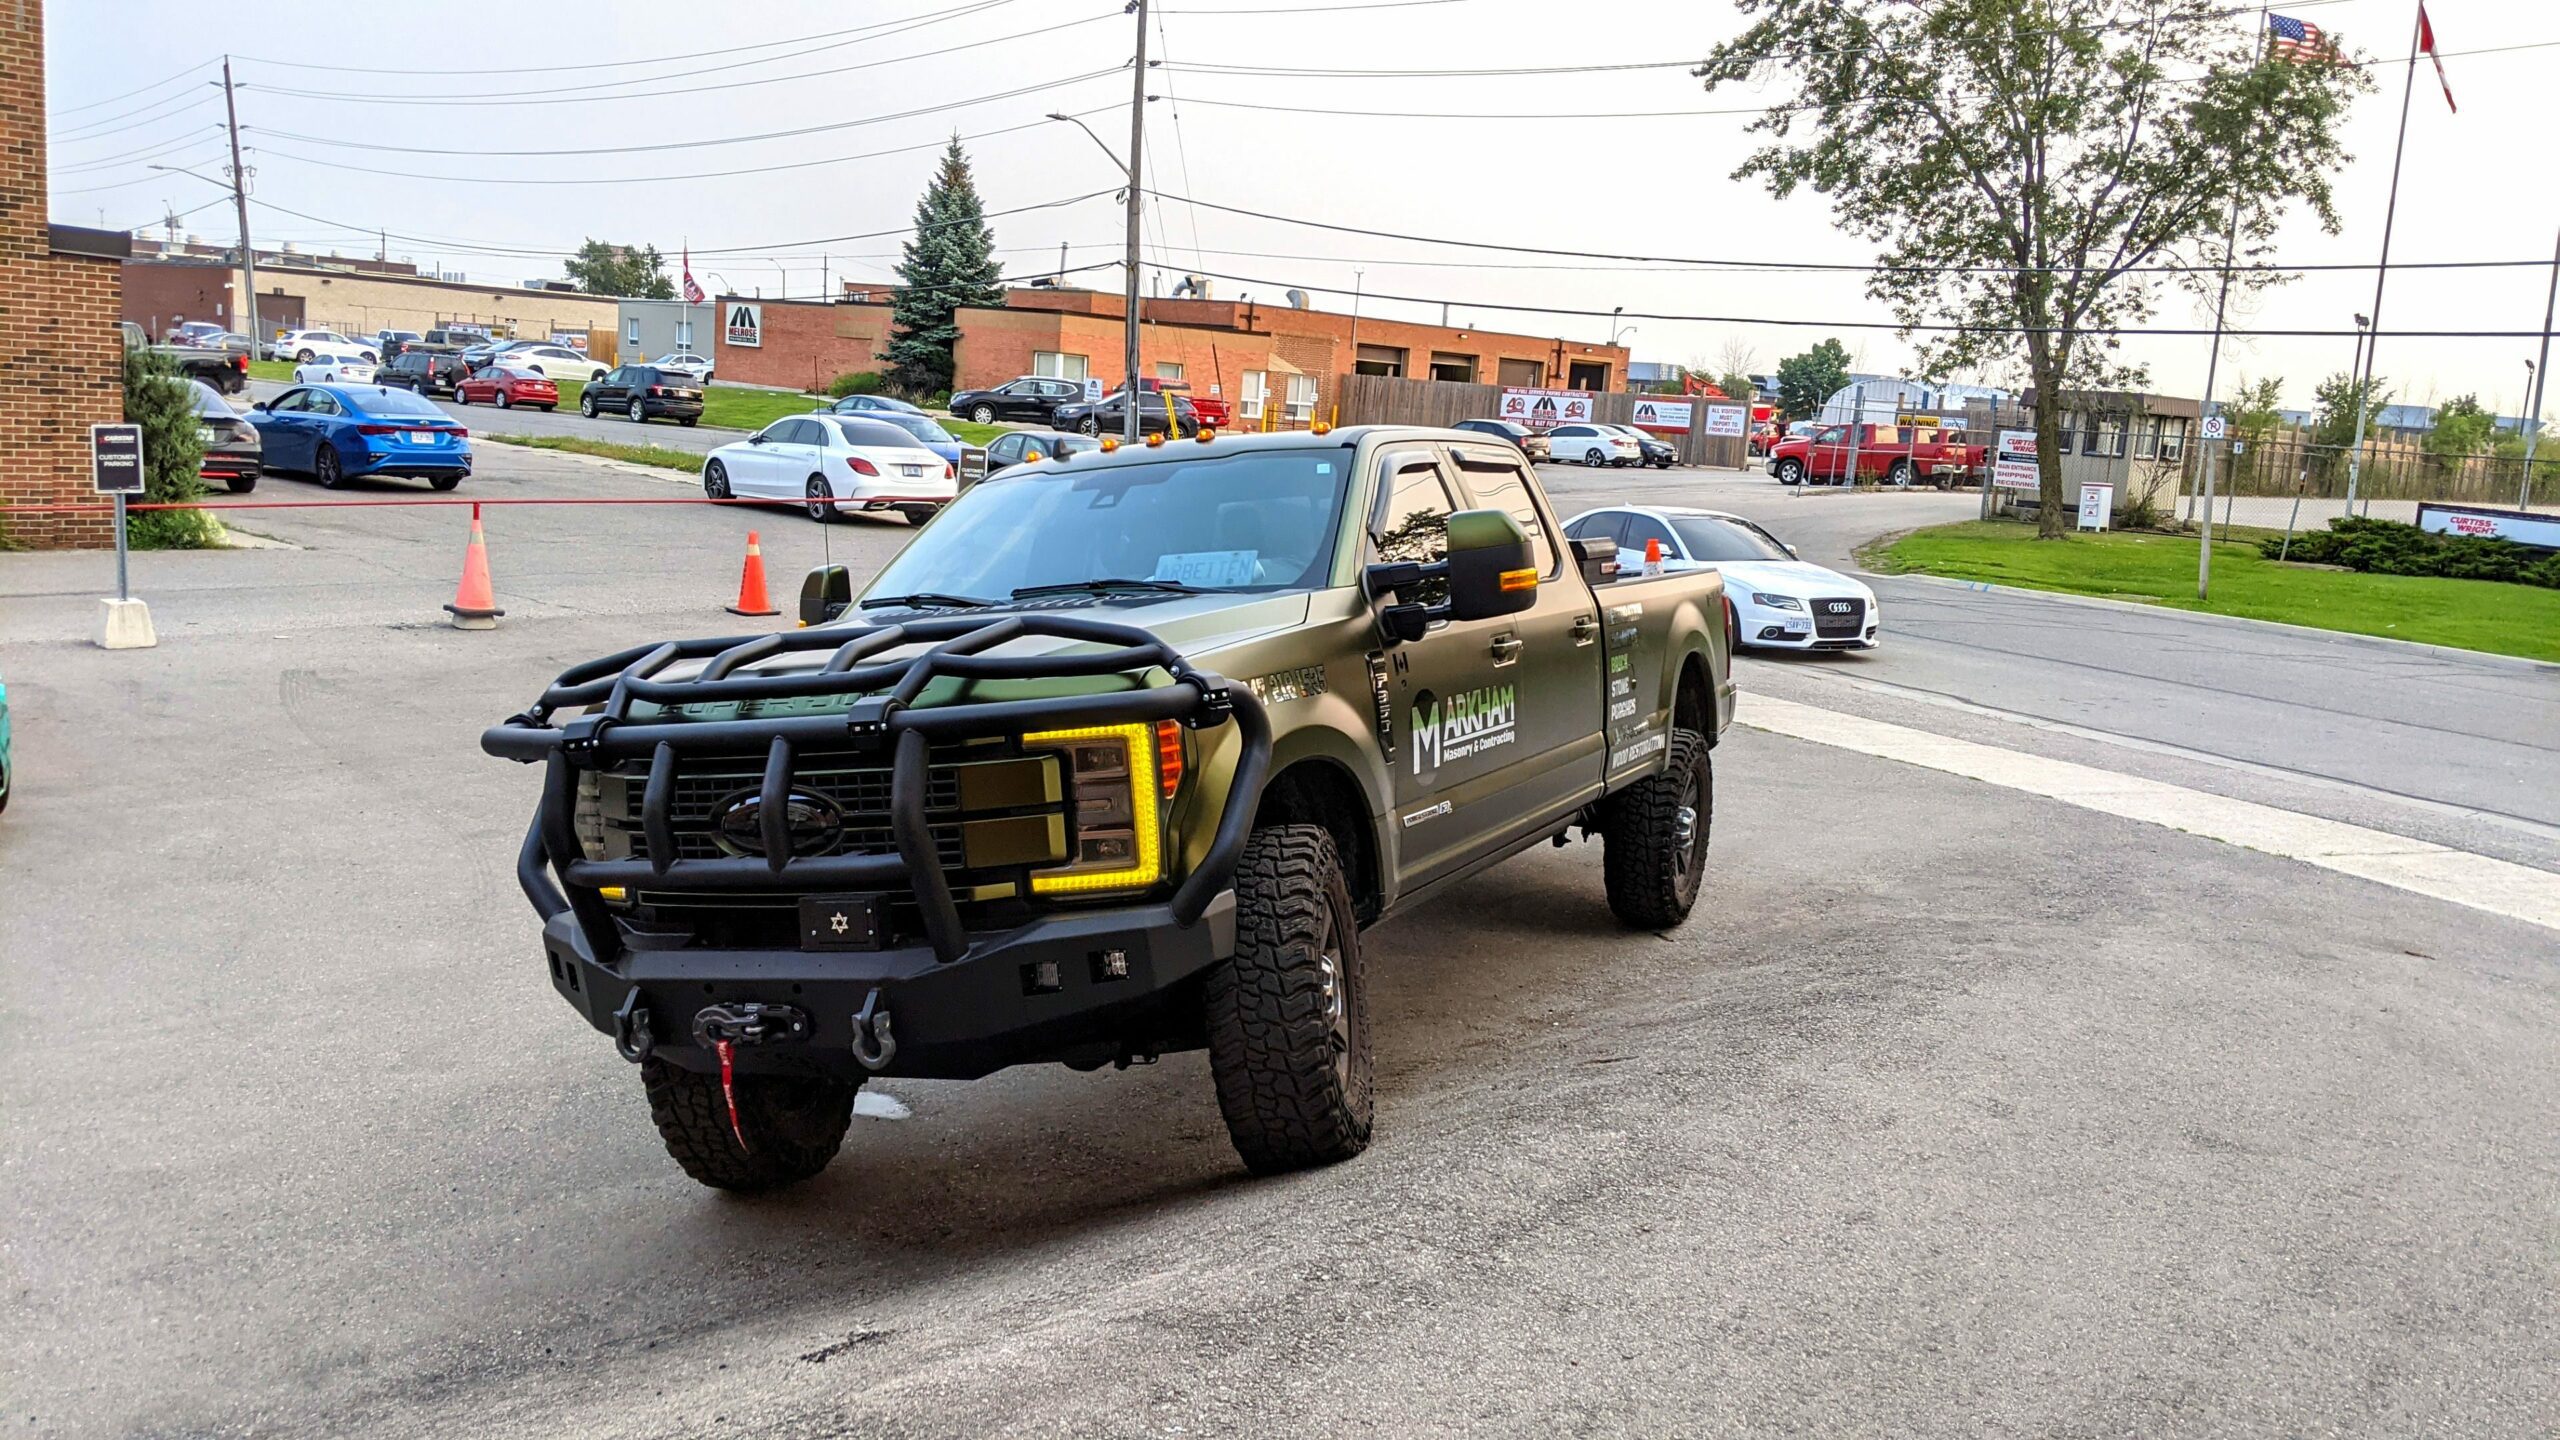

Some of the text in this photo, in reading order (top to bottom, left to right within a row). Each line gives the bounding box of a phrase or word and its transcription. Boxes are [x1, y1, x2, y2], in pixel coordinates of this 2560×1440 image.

[728, 327, 757, 338] MELROSE
[1531, 409, 1558, 417] MELROSE
[2007, 438, 2038, 447] CURTIS
[2011, 464, 2037, 472] ENTRANCE
[1997, 471, 2034, 480] SHIPPING
[1995, 479, 2036, 488] RECEIVING
[2457, 524, 2498, 535] WRIGHT
[1160, 560, 1251, 581] ARBEITEN
[1611, 677, 1630, 698] STONE
[1411, 684, 1516, 775] MARKHAM
[1443, 729, 1516, 763] Masonry & Contracting
[1611, 733, 1666, 770] WOOD RESTORATION
